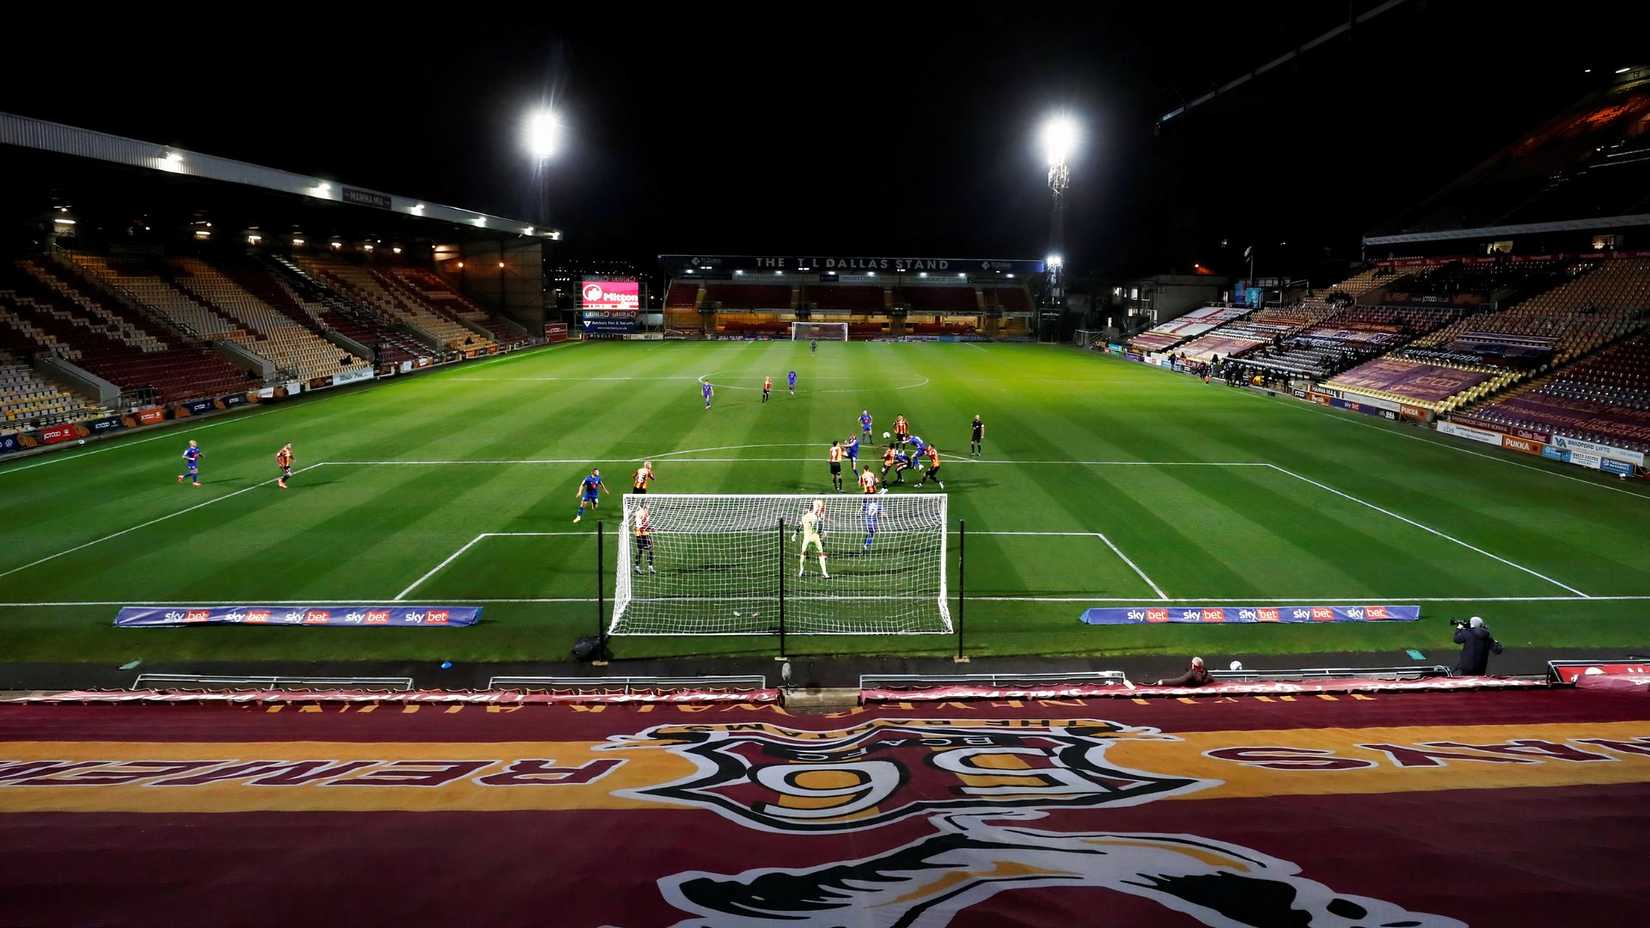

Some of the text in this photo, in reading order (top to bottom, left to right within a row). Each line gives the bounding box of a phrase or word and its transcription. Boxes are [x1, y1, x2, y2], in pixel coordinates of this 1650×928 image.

[755, 257, 949, 270] THE T L DALLAS STAND
[1505, 438, 1530, 450] PUKKA
[164, 610, 208, 623] sky bet
[226, 610, 266, 623] sky bet
[285, 610, 327, 623] sky bet
[345, 610, 387, 623] sky bet
[405, 610, 447, 623] sky bet
[1127, 609, 1166, 621] sky bet
[1183, 609, 1222, 621] sky bet
[1239, 608, 1278, 621] sky bet
[1293, 607, 1332, 620] sky bet
[1347, 607, 1386, 619] sky bet
